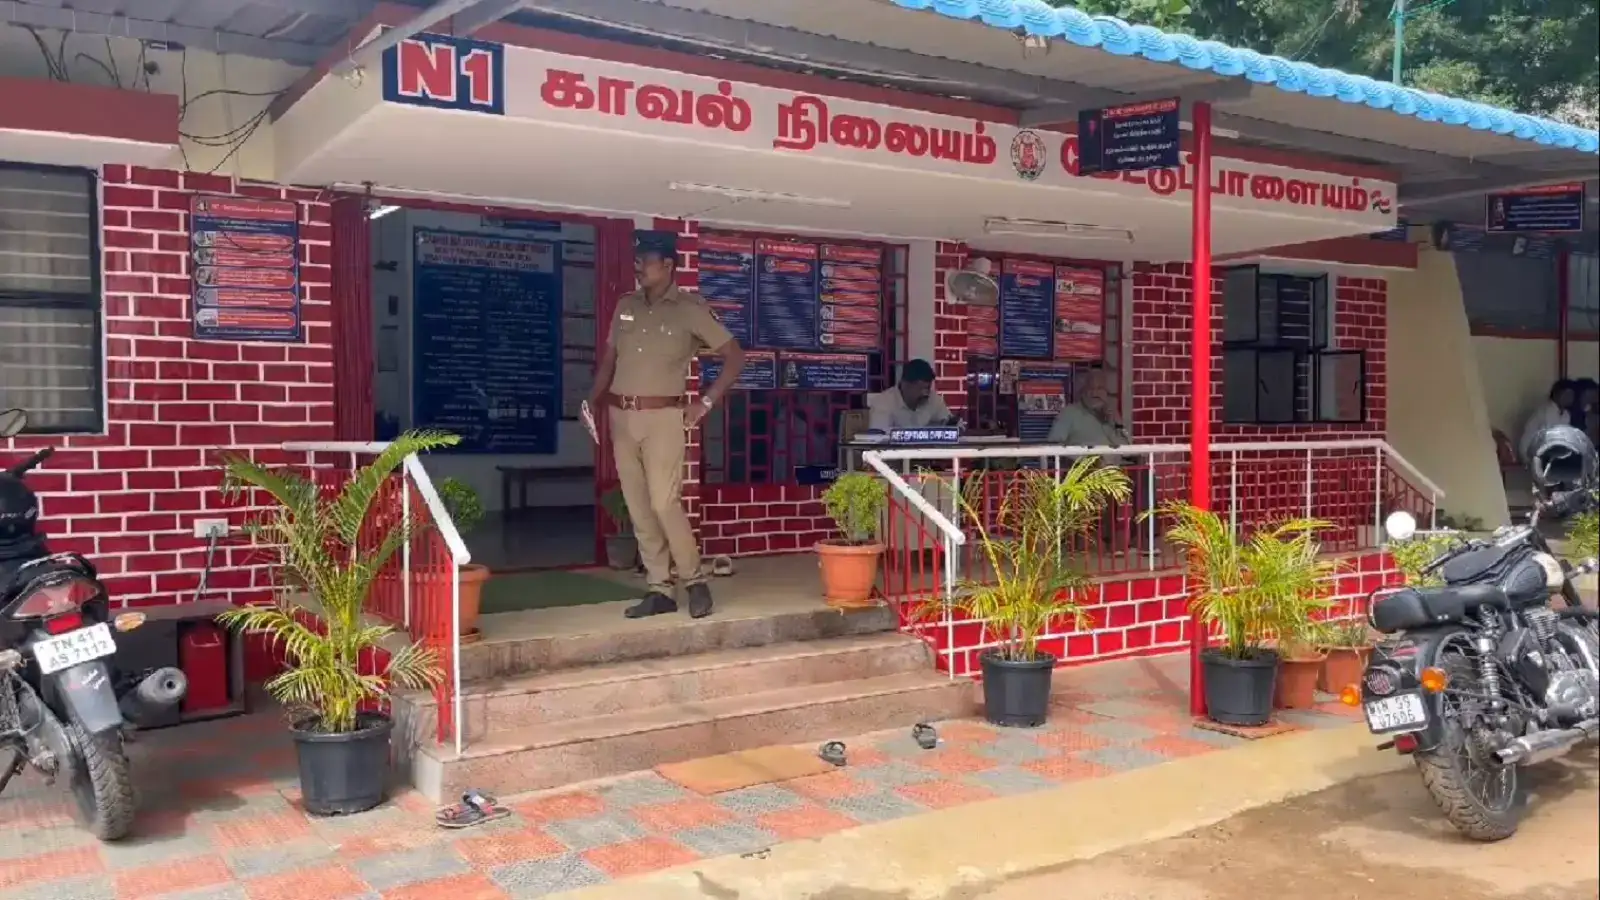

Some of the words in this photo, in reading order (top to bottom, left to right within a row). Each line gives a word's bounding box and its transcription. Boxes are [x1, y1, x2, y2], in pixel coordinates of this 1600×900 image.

[398, 40, 493, 104] N1
[540, 67, 752, 132] காவல்
[773, 95, 997, 165] நிலையம்
[891, 430, 929, 440] RECEPTION
[930, 430, 957, 440] OFFICER
[51, 636, 73, 653] TN
